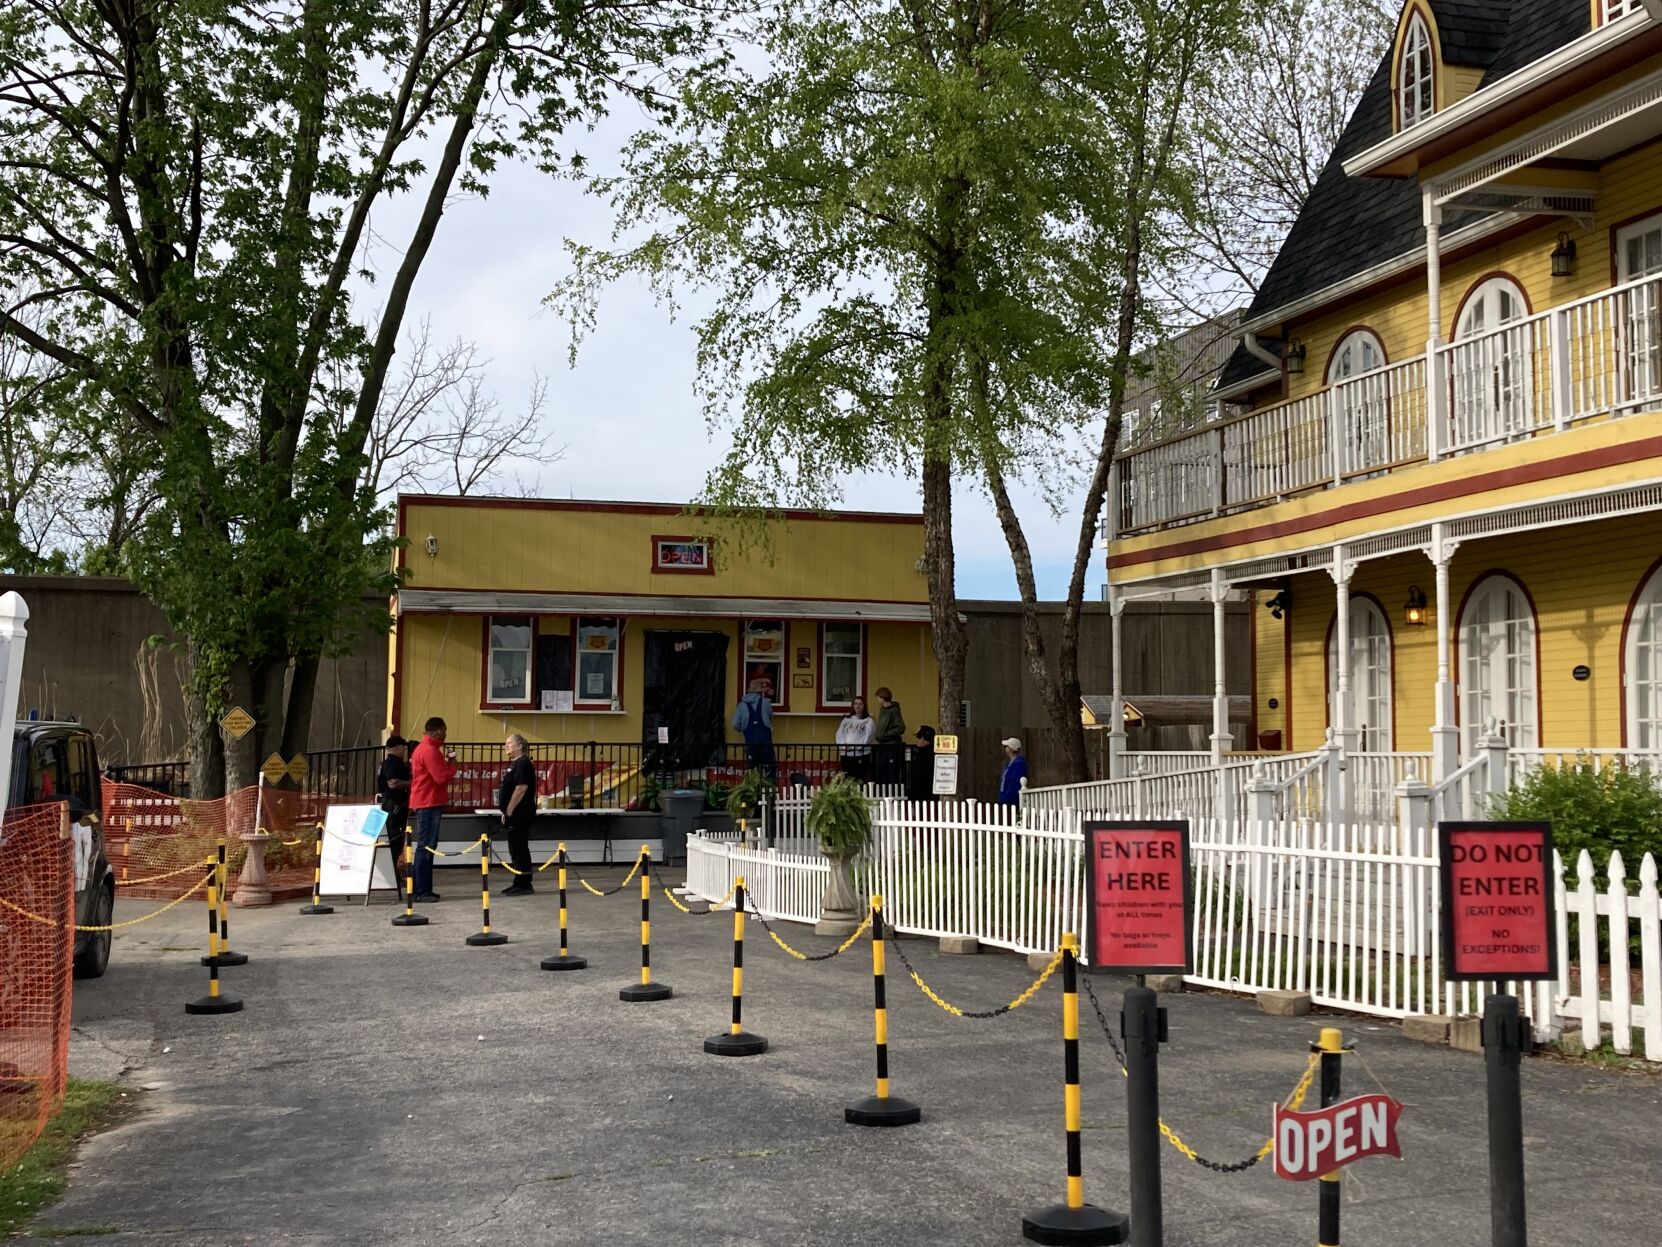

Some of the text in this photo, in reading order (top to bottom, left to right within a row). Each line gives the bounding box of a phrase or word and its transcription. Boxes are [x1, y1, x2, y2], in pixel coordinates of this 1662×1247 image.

[661, 551, 703, 563] OPEN
[674, 640, 693, 652] OPEN
[500, 678, 519, 689] OPEN
[832, 686, 851, 696] OPEN
[1100, 841, 1176, 859] ENTER
[1451, 844, 1544, 863] DO NOT
[1107, 872, 1171, 891] HERE
[1459, 877, 1540, 896] ENTER
[1465, 905, 1535, 917] (EXIT ONLY)
[1491, 929, 1511, 939] NO
[1462, 944, 1541, 954] EXCEPTIONS!
[1280, 1102, 1388, 1174] OPEN
